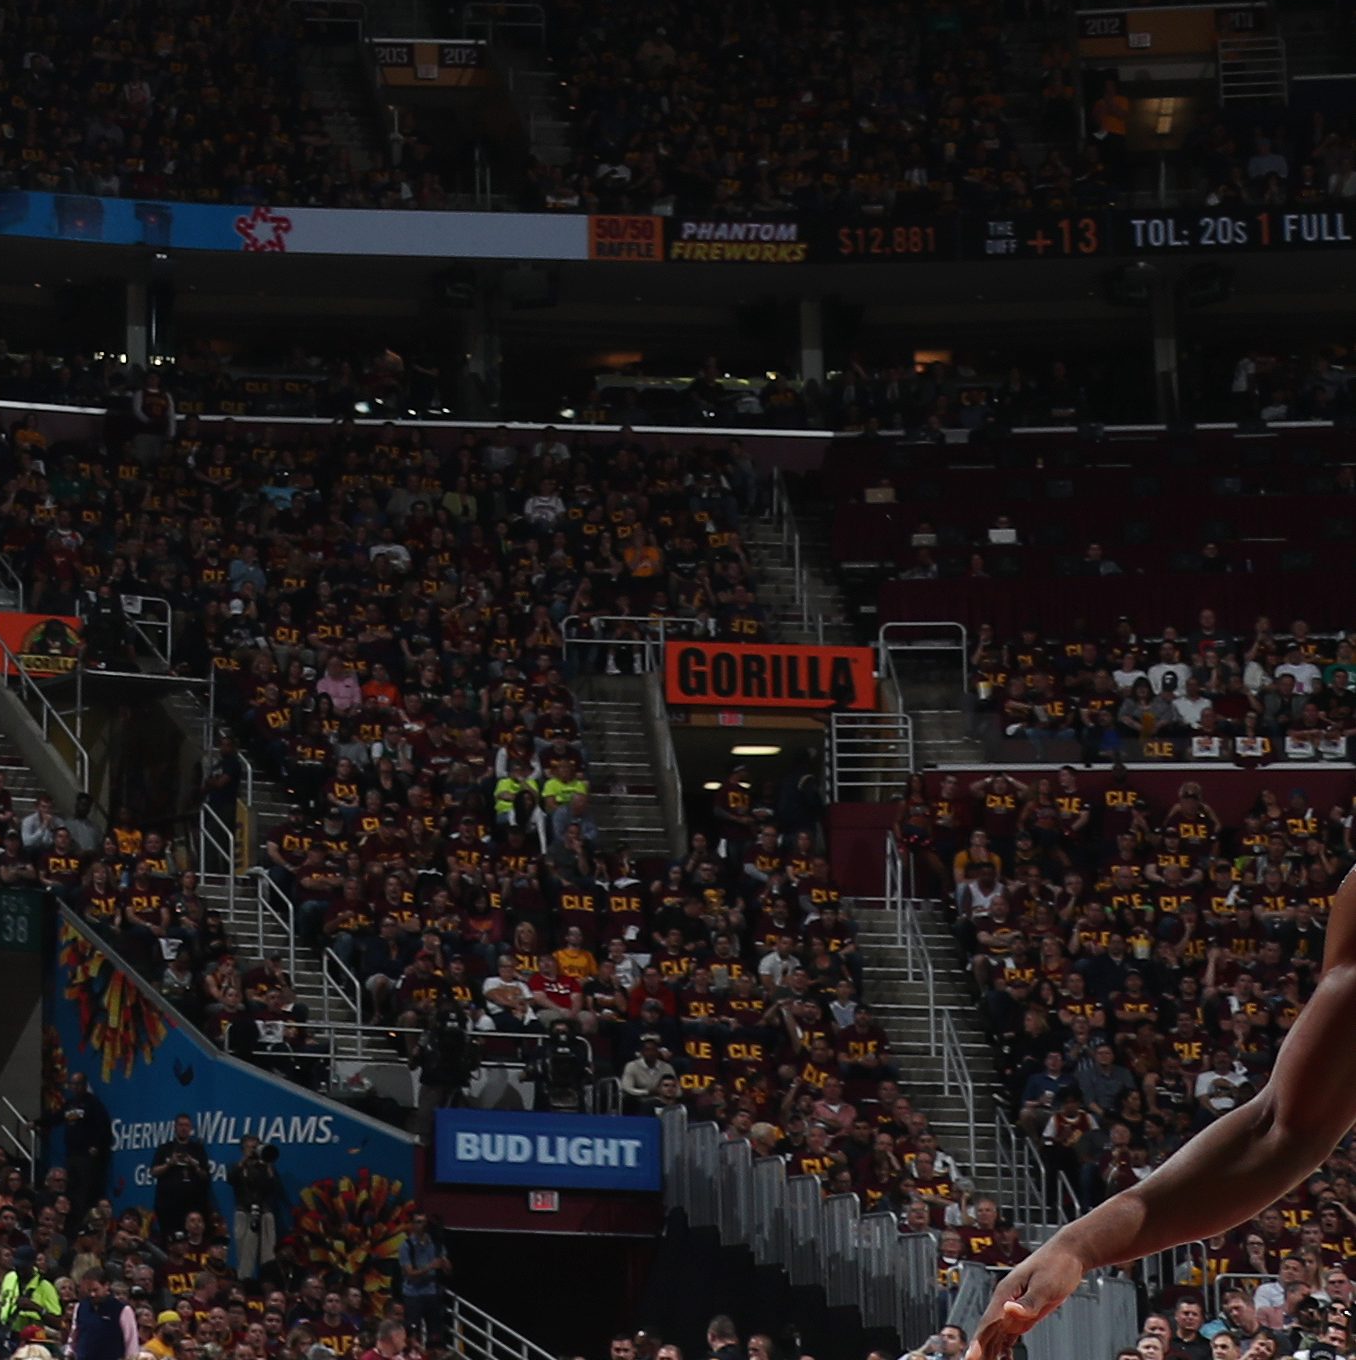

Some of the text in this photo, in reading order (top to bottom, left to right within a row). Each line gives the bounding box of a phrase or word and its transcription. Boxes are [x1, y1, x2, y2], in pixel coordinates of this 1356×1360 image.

[596, 218, 655, 239] 50/50
[682, 222, 798, 241] PHANTOM
[987, 221, 1015, 236] THE
[1131, 213, 1352, 248] TOL: 20s 1 FULL
[670, 242, 808, 262] FIREWORKS
[839, 226, 937, 257] $12,881
[679, 647, 855, 704] GORILLA
[561, 893, 594, 912] CLE
[610, 896, 641, 913] CLE
[2, 915, 29, 943] 38
[727, 1043, 764, 1061] CLE
[110, 1110, 340, 1152] SHERWI-WILLIAMS.
[455, 1131, 643, 1168] BUD LIGHT
